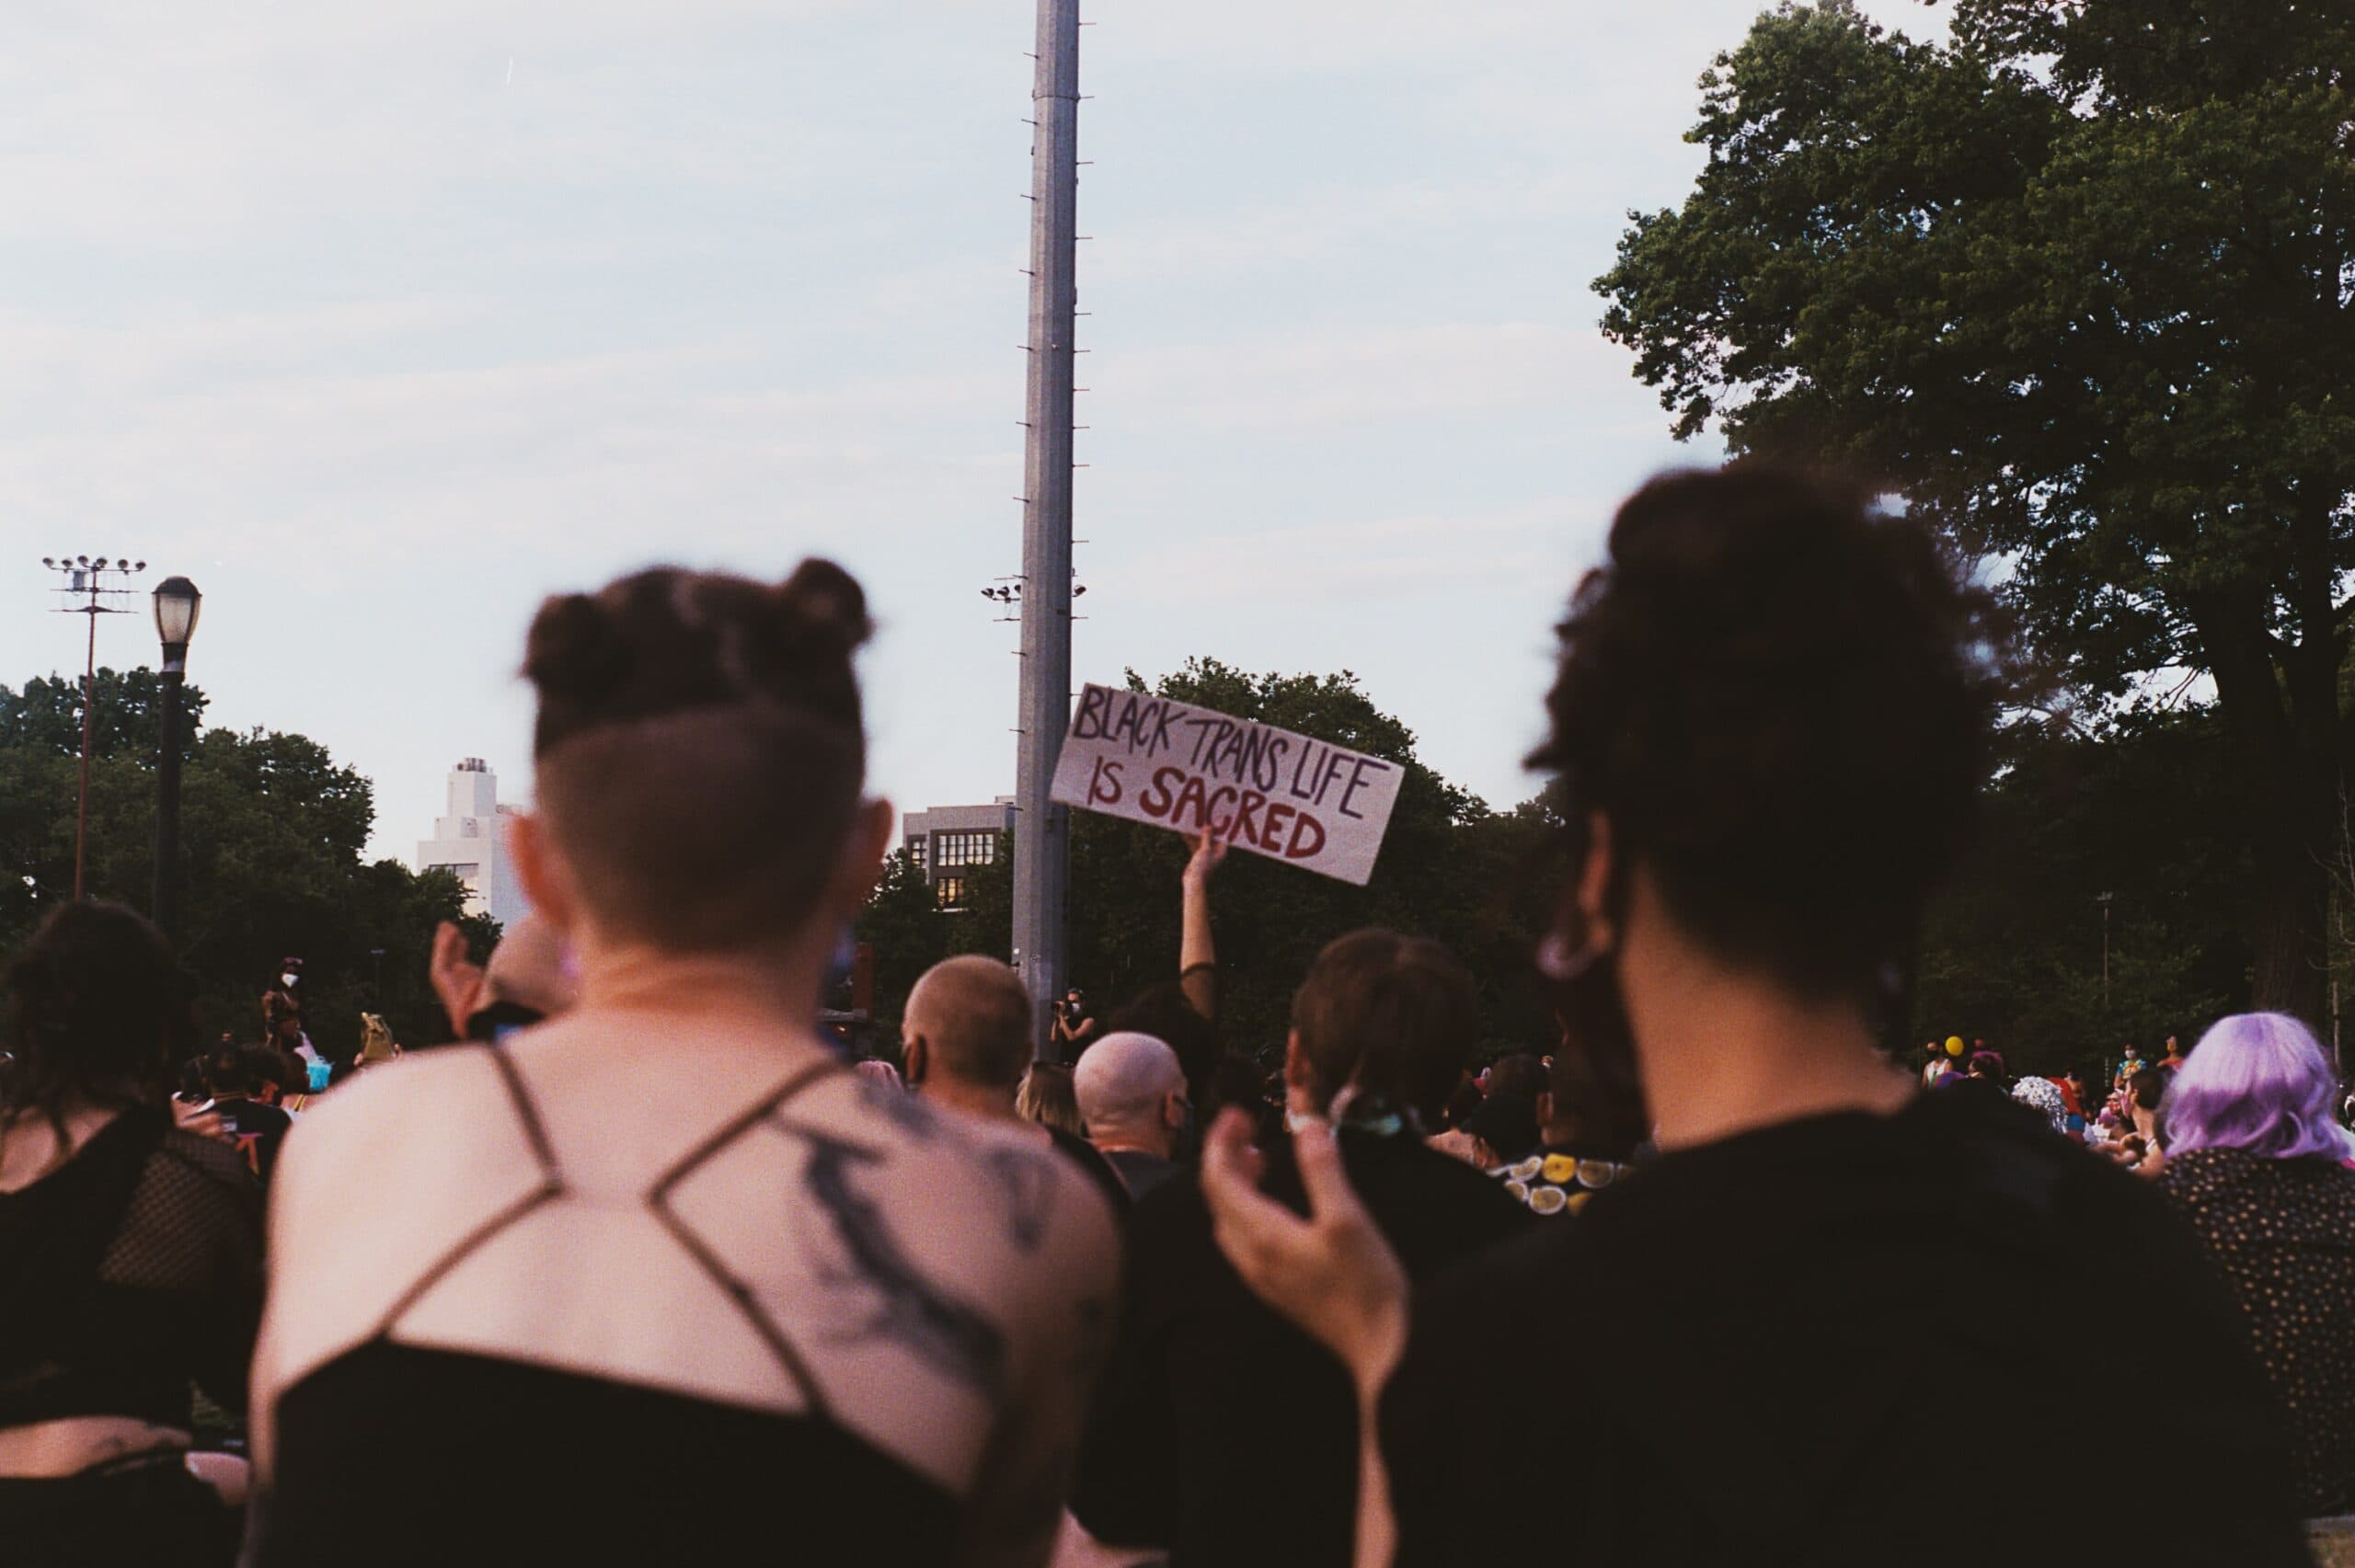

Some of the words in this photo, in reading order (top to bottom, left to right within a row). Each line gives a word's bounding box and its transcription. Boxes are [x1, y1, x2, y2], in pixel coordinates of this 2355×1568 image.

[1072, 686, 1187, 758] BLACK
[1187, 718, 1288, 793] TRANS
[1291, 740, 1390, 820] LIFE
[1087, 755, 1123, 806] IS
[1139, 766, 1327, 860] SACRED
